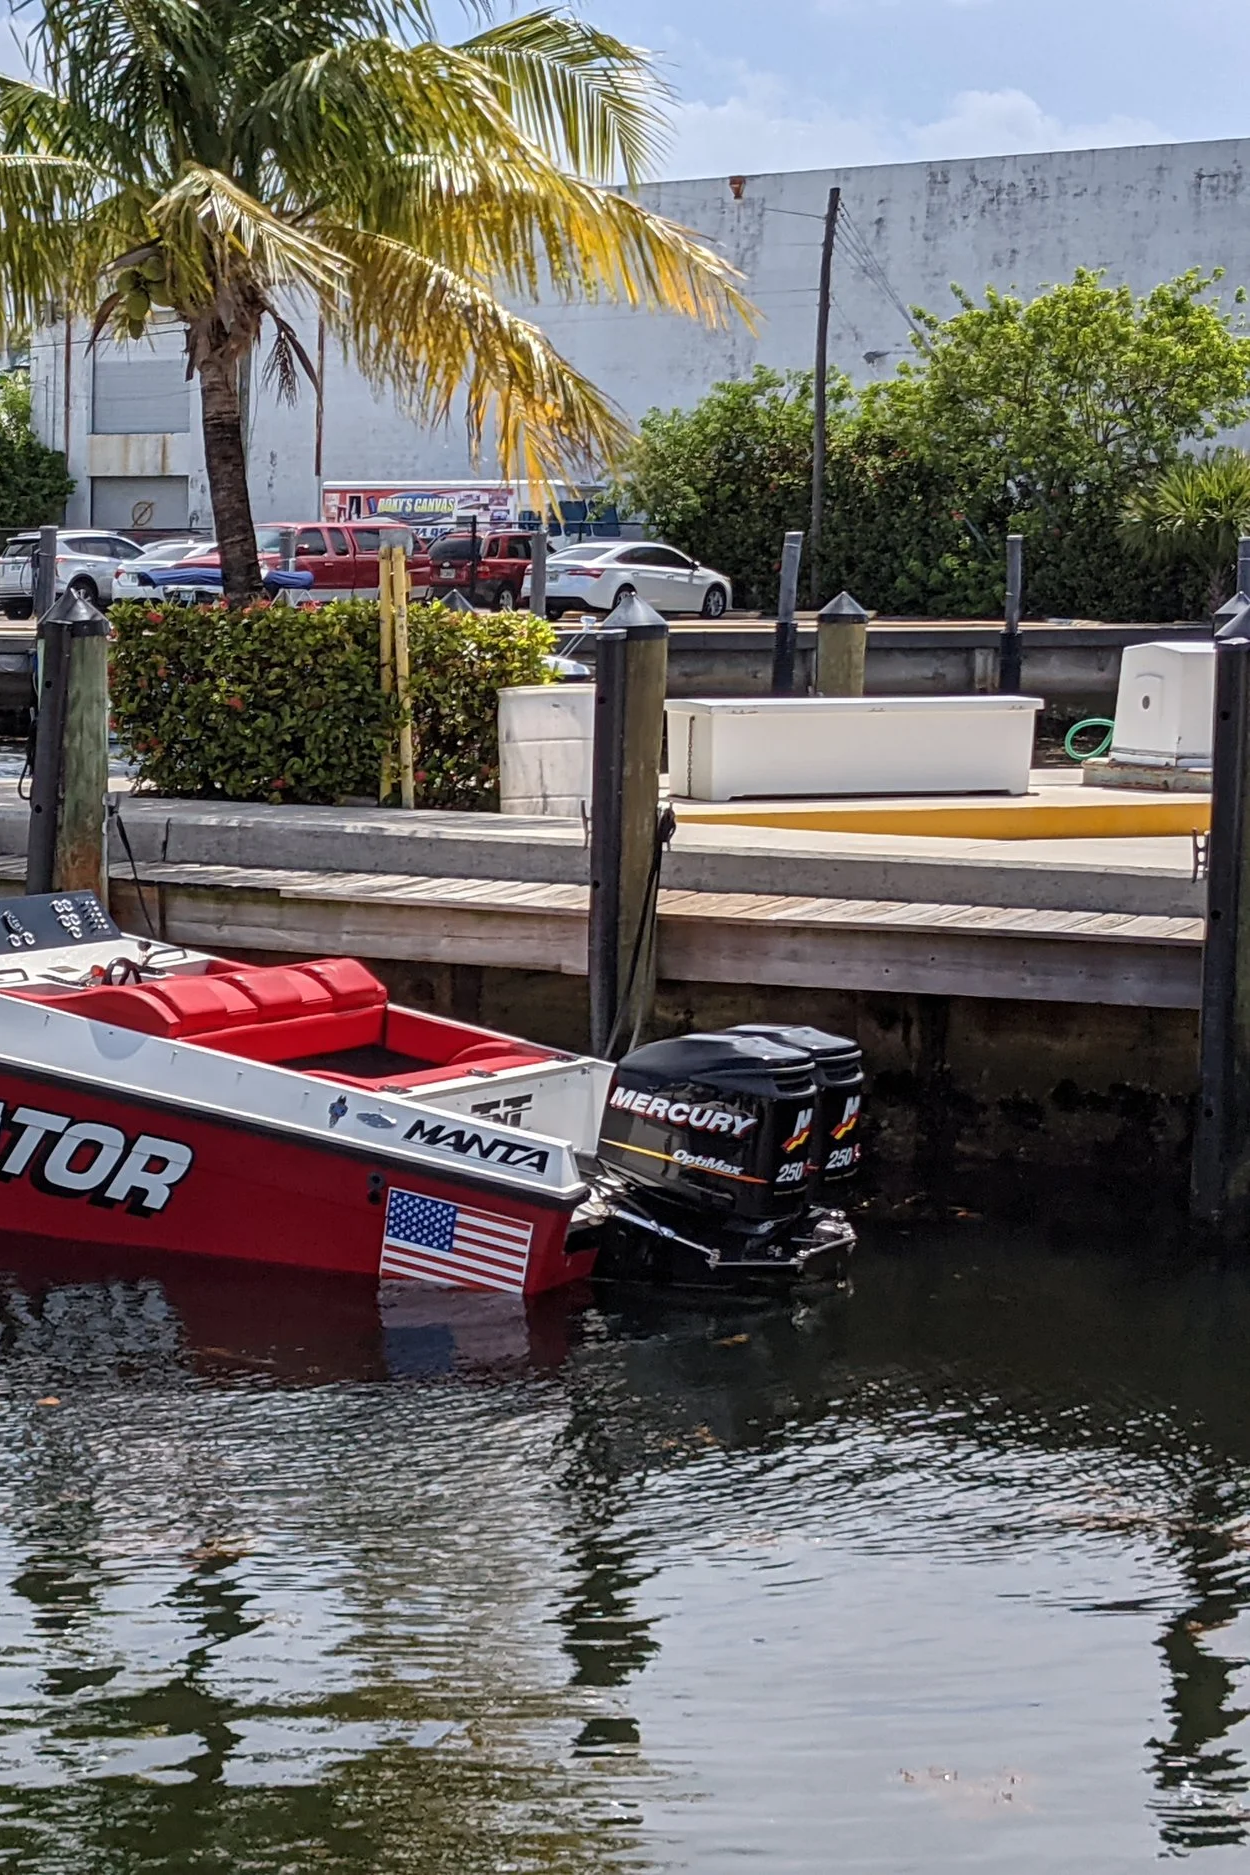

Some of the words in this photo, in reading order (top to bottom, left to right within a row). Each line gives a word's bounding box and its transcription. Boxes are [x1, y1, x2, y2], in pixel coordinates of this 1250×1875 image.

[414, 497, 455, 513] CANVAS
[609, 1086, 758, 1138] MERCURY
[403, 1119, 549, 1174] MANTA
[825, 1147, 853, 1169] 250
[672, 1149, 743, 1176] OptiMax
[775, 1161, 804, 1182] 250
